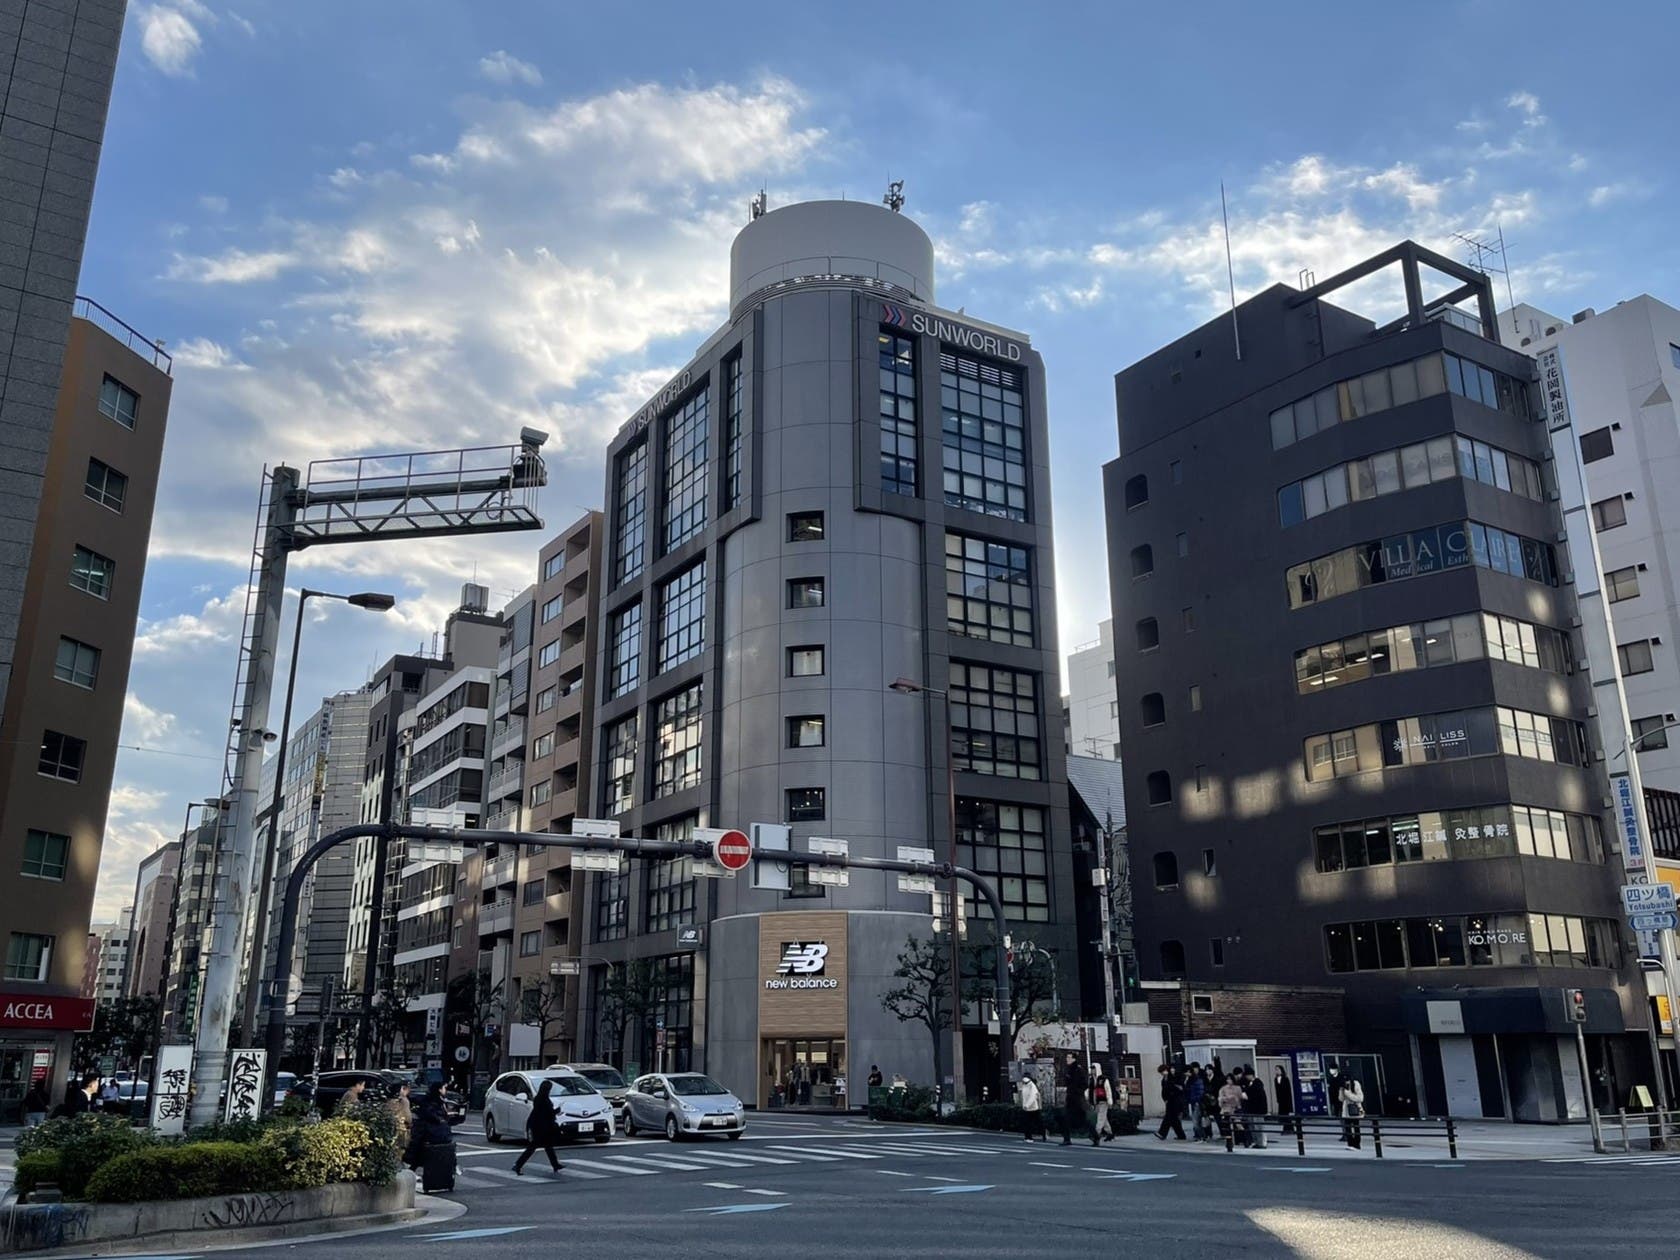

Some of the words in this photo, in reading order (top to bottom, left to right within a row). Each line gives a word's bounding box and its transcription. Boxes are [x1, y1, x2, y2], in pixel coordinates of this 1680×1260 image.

[911, 314, 1021, 361] SUNWORLD
[638, 371, 692, 430] SUNWORLD
[1626, 886, 1671, 902] 四ツ橋
[765, 980, 788, 989] new
[790, 977, 838, 988] balance
[3, 1002, 54, 1020] ACCEA
